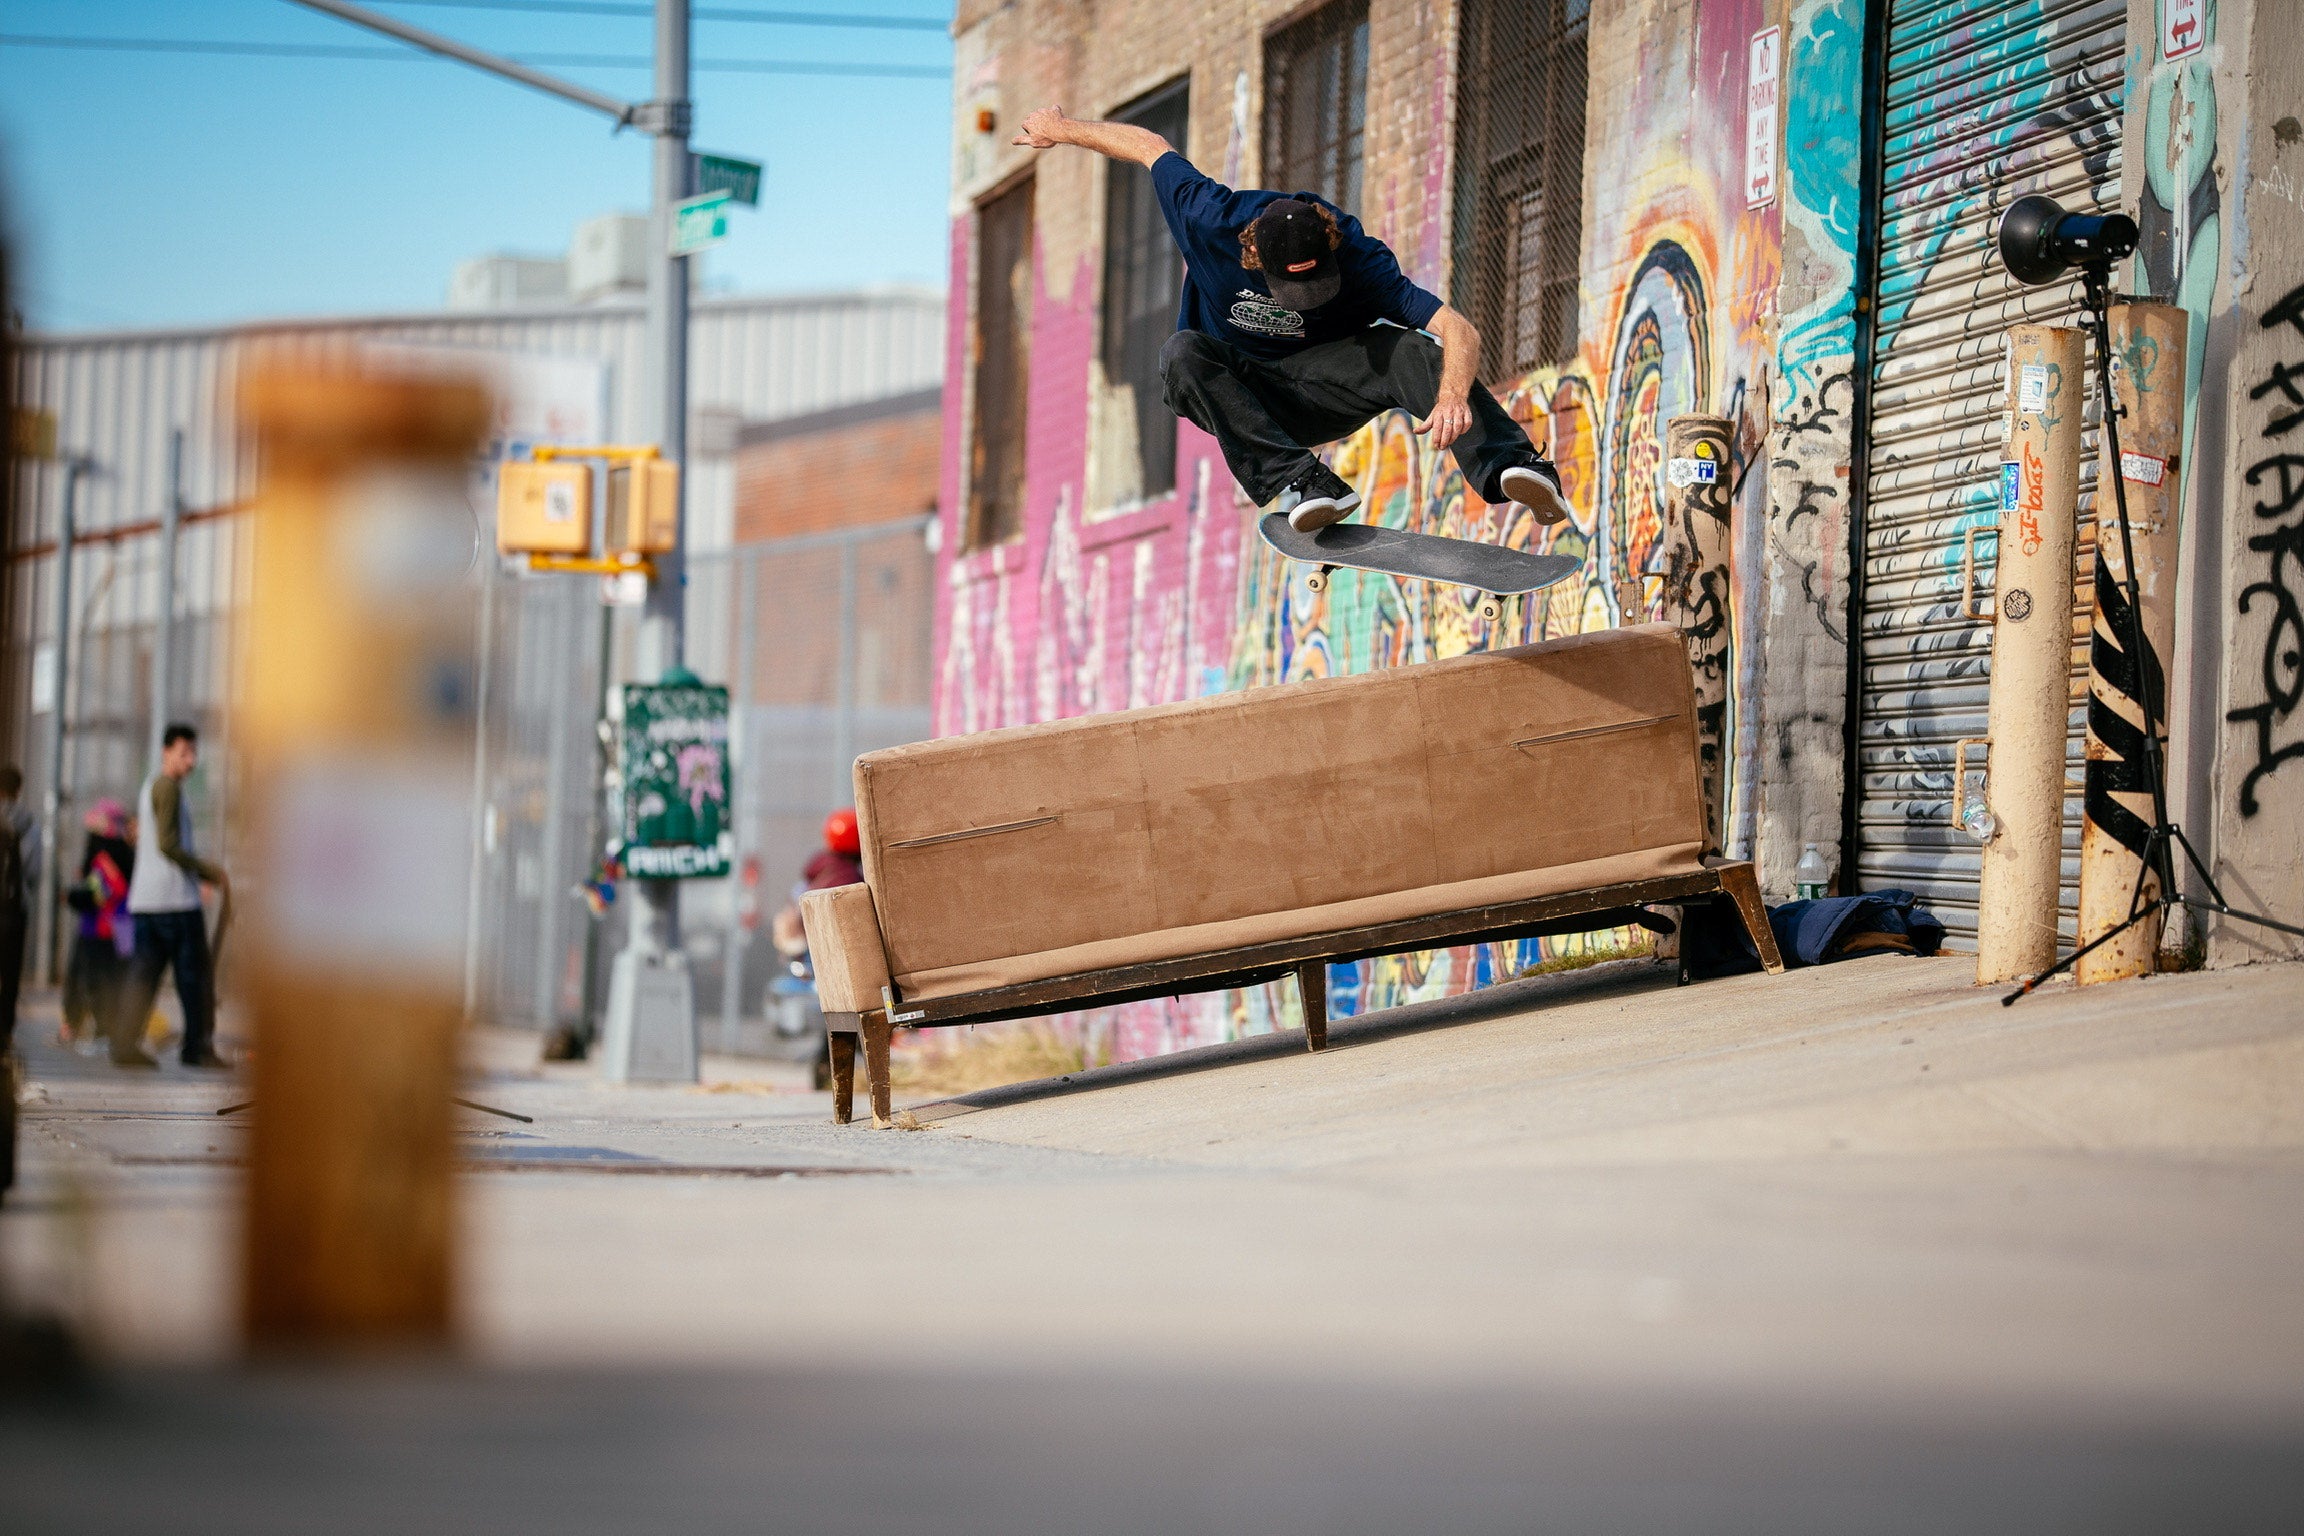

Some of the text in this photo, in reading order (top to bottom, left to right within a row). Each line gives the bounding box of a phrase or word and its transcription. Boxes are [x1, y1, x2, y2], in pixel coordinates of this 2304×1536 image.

[1759, 46, 1770, 76] NO
[1751, 78, 1776, 113] PARKING
[1756, 116, 1769, 141] ANY
[1755, 142, 1768, 167] TIME
